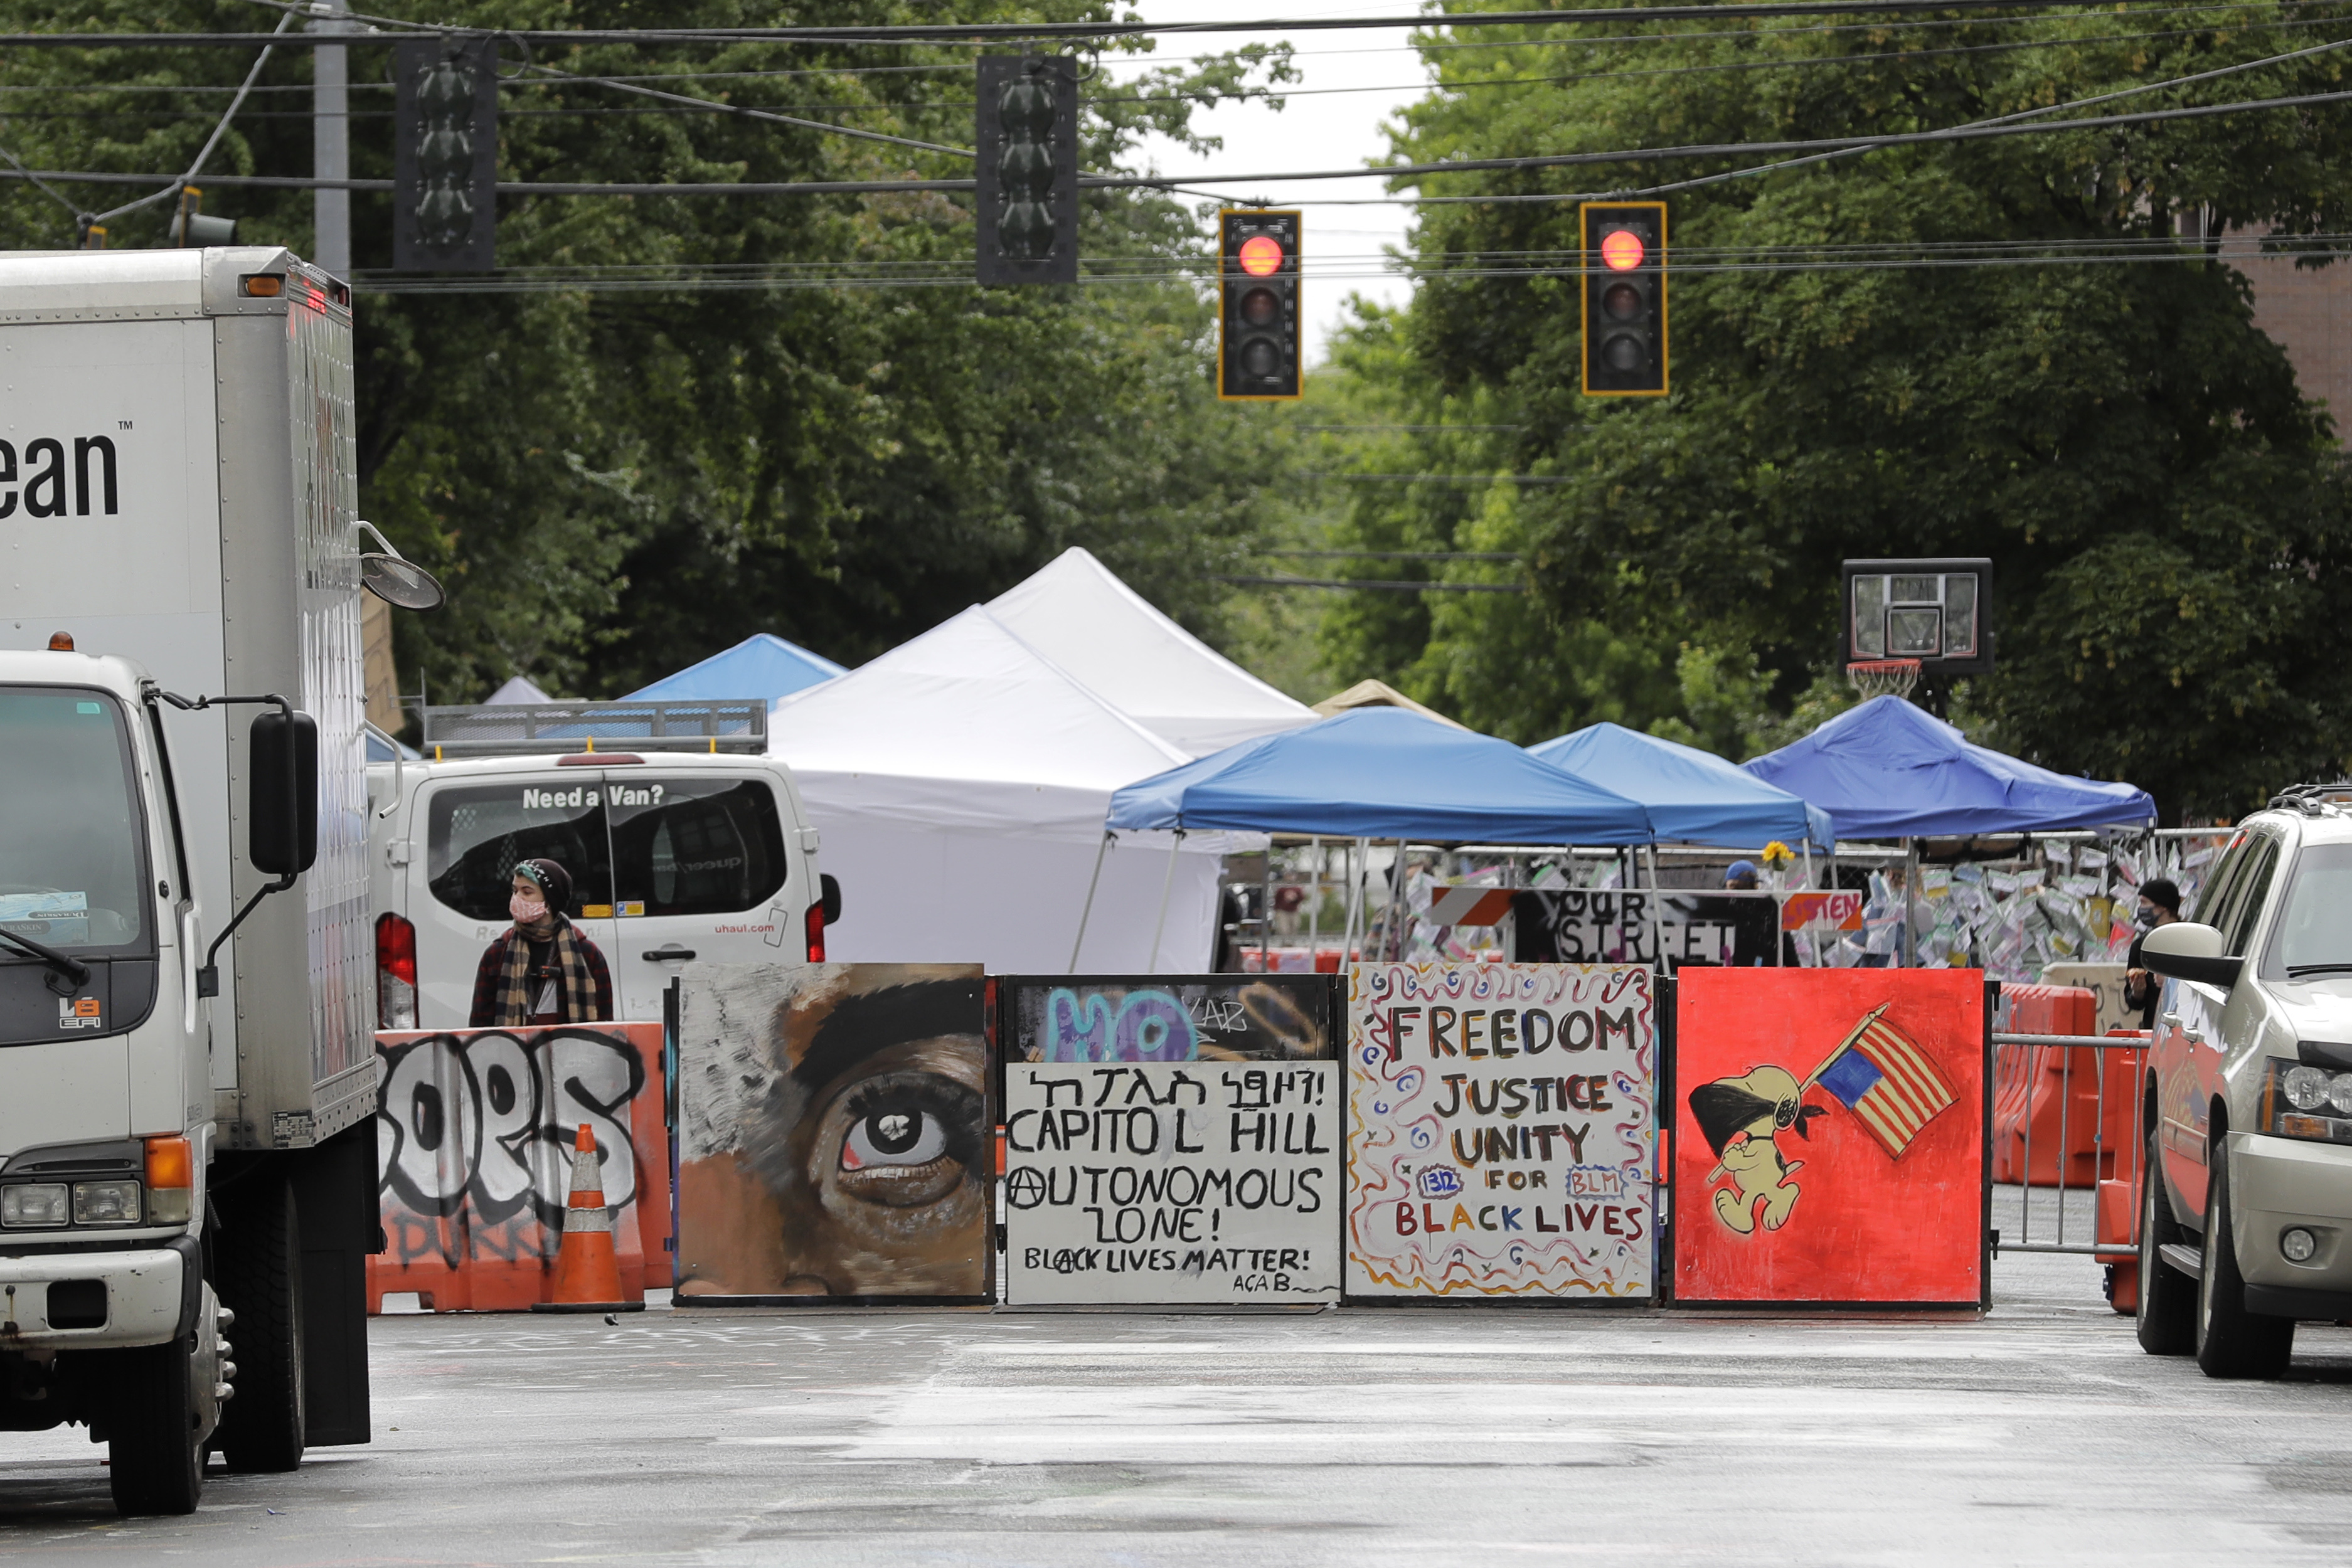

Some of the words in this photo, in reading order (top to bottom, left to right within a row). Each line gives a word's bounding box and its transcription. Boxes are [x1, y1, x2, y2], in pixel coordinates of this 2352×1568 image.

[523, 787, 582, 809] Need
[585, 790, 599, 807] a
[609, 784, 664, 806] Van?
[1783, 893, 1861, 924] LISTEN
[715, 924, 774, 933] uhaul.com
[59, 997, 100, 1017] V8
[1388, 1006, 1637, 1062] FREEDOM
[1434, 1073, 1614, 1118] JUSTICE
[1007, 1106, 1204, 1155] CAPITOL
[1230, 1112, 1329, 1154] HILL
[1451, 1123, 1591, 1168] UNITY
[1007, 1165, 1323, 1213] AUTONOMOUS
[1485, 1169, 1548, 1190] FOR
[1572, 1172, 1619, 1194] BLM
[1082, 1207, 1220, 1244] ZONE!
[1397, 1202, 1524, 1237] BLACK
[1535, 1203, 1642, 1241] LIVES
[1024, 1247, 1102, 1274] BLACK
[1106, 1248, 1177, 1273] LIVES
[1181, 1248, 1310, 1273] MATTER!
[1233, 1273, 1291, 1293] ACAB
